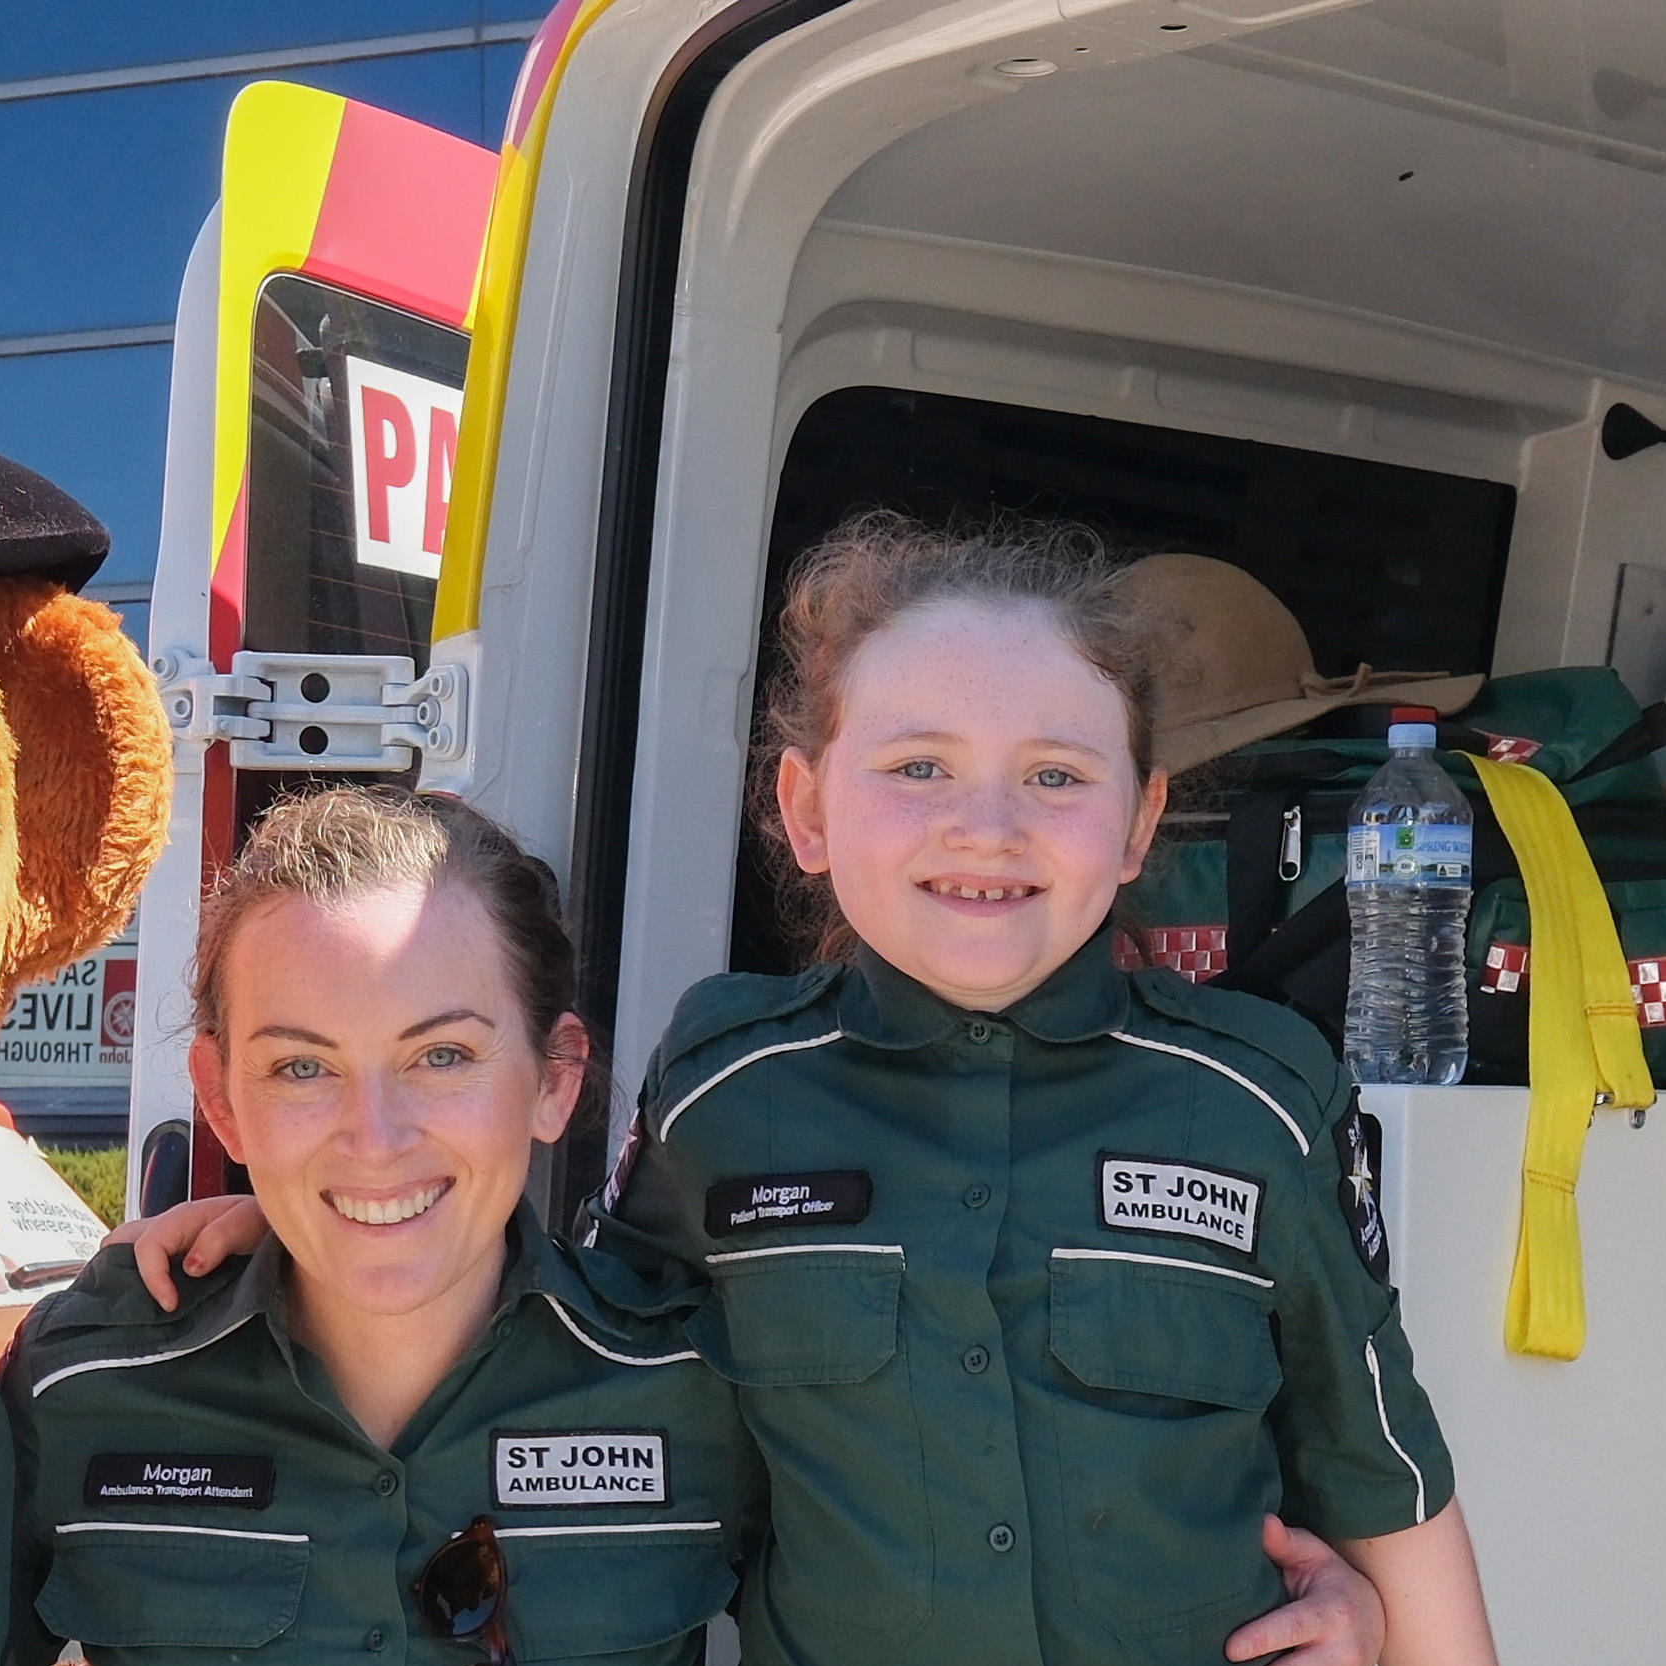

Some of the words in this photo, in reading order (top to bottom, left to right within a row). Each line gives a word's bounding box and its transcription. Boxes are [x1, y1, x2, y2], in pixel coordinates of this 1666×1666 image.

[752, 1185, 810, 1205] Morgan
[1112, 1171, 1157, 1195] ST
[1166, 1176, 1248, 1216] JOHN
[757, 1204, 799, 1218] Transport
[1113, 1202, 1244, 1240] AMBULANCE
[507, 1447, 550, 1469] ST
[561, 1446, 654, 1469] JOHN
[143, 1464, 211, 1484] Morgan
[508, 1475, 655, 1492] AMBULANCE
[100, 1484, 154, 1496] Ambulance
[155, 1485, 202, 1498] Transport
[204, 1486, 253, 1498] Attendant
